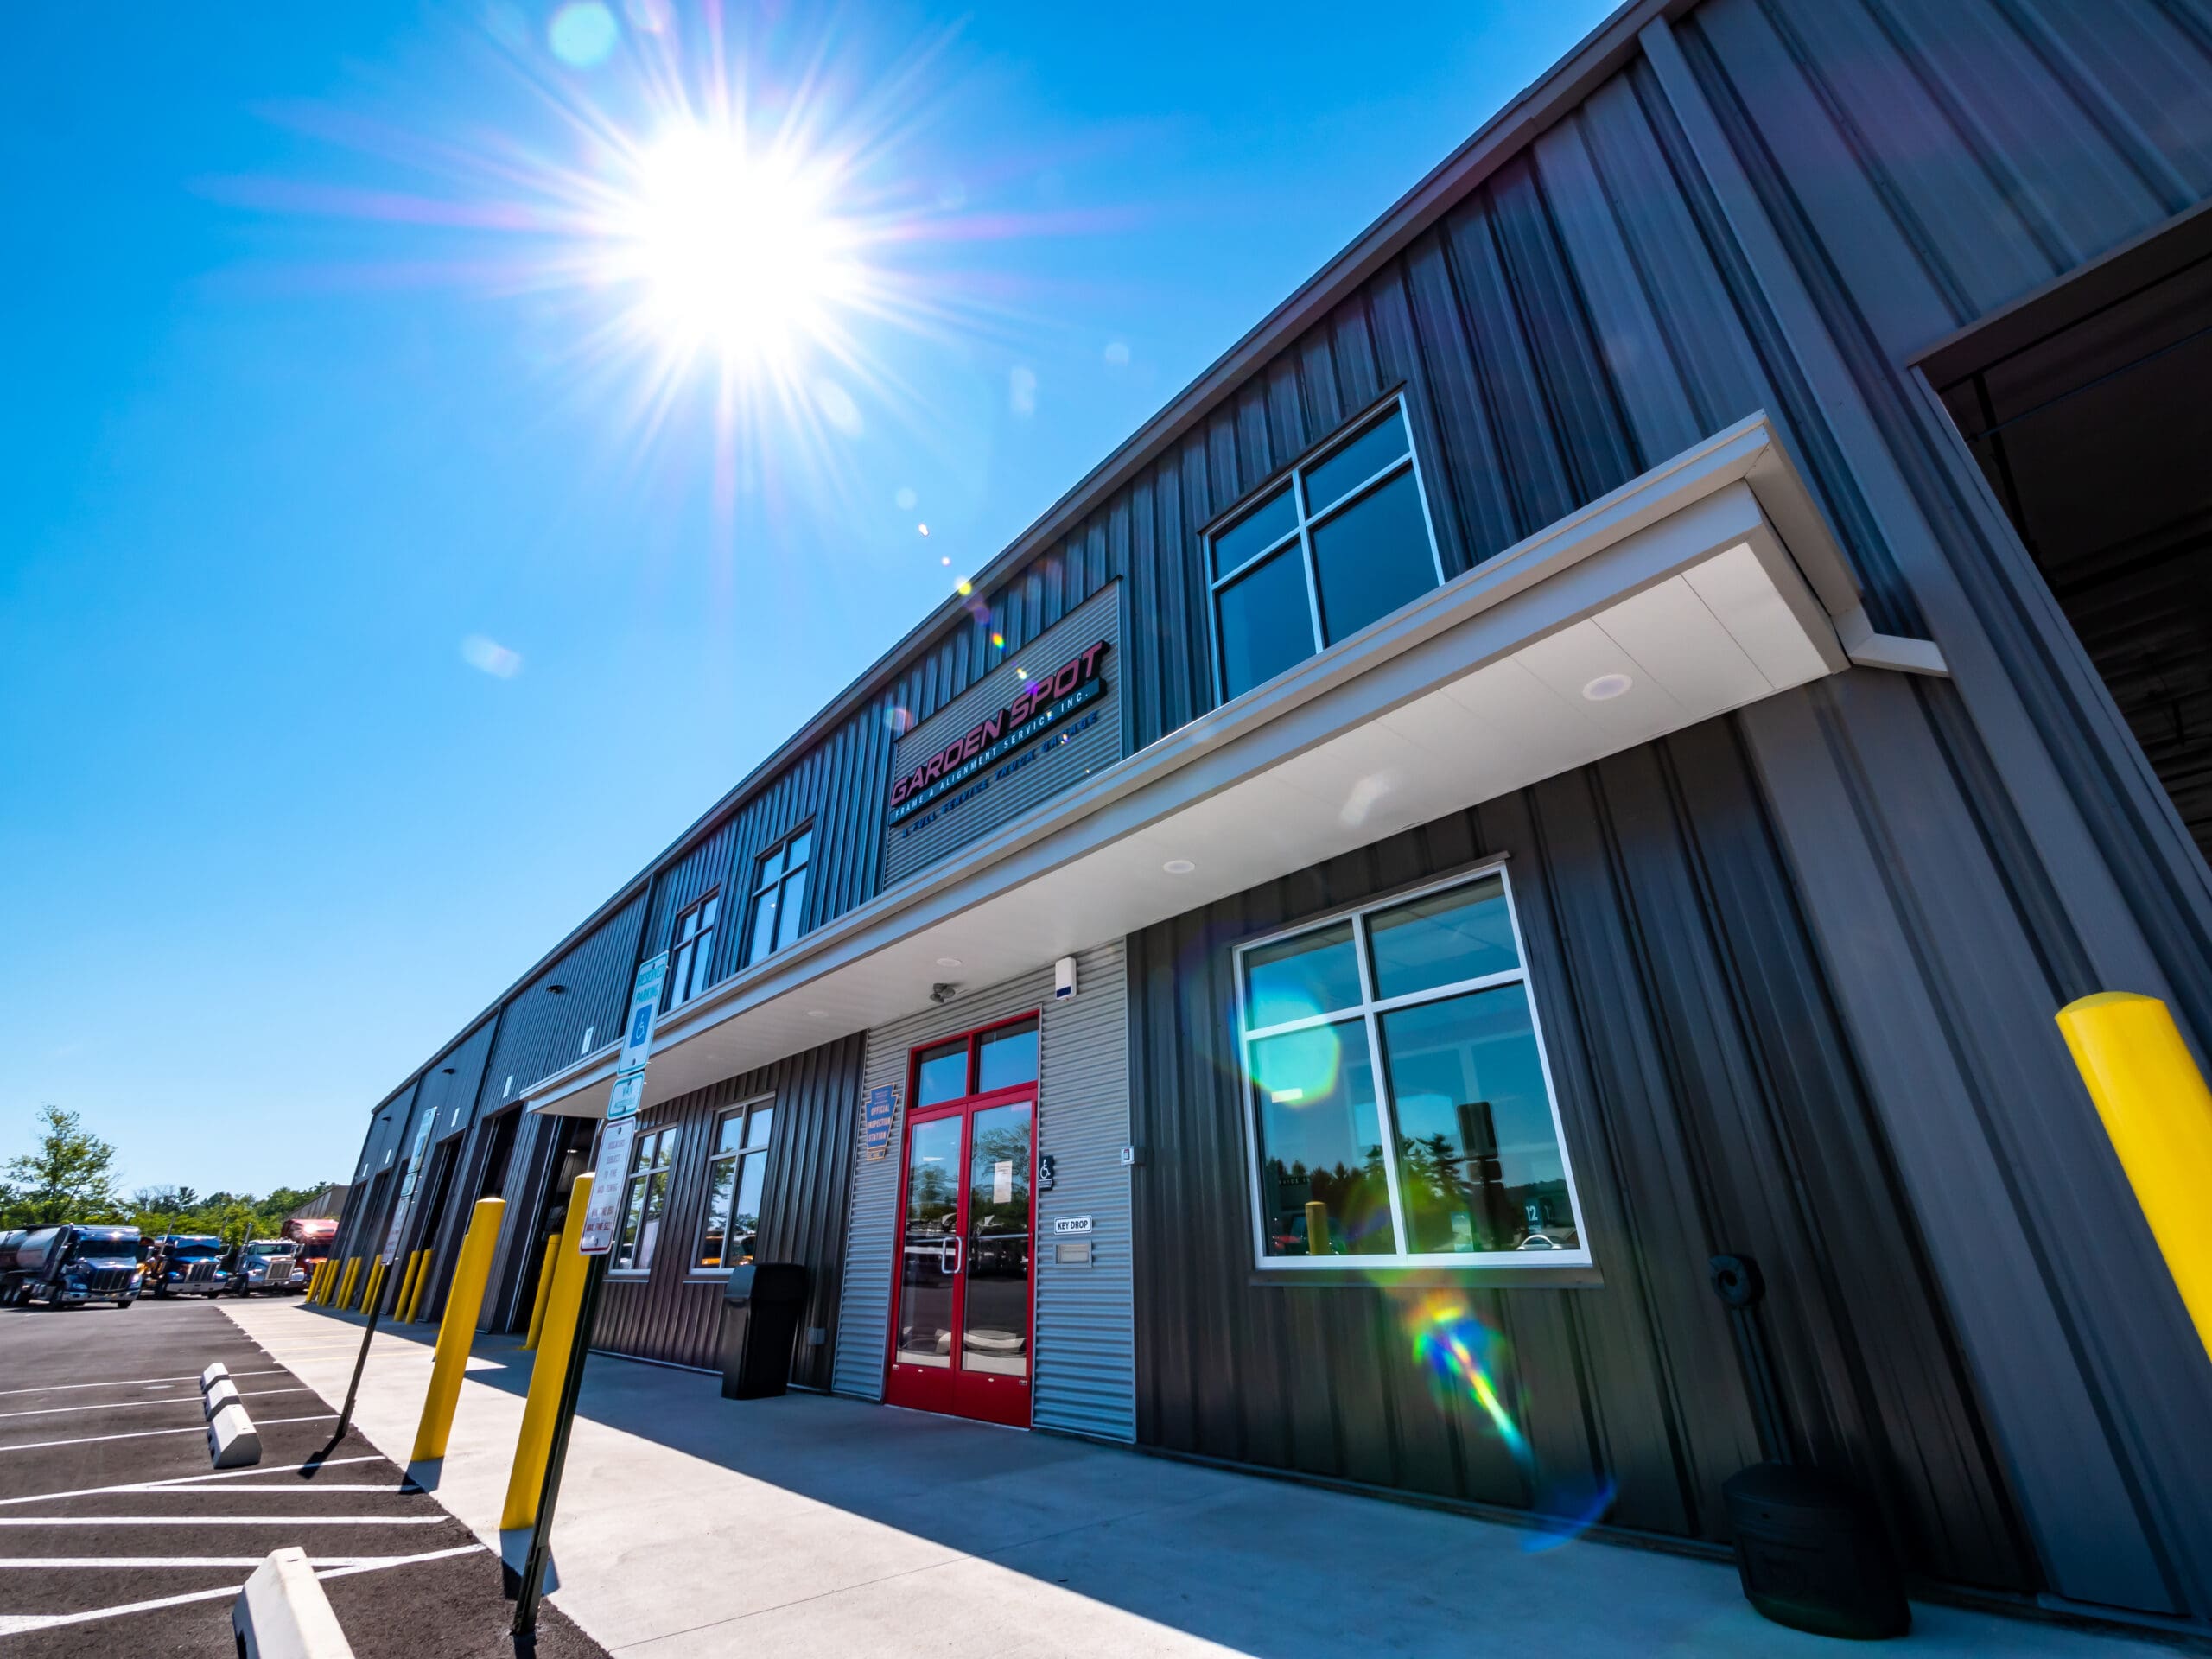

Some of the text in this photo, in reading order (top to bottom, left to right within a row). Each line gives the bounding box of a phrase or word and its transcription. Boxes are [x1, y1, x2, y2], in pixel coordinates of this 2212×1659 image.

[891, 641, 1103, 806] GARDEN SPOT
[895, 797, 924, 818] FRAME
[939, 747, 997, 790] ALIGNMENT
[1004, 710, 1053, 749] SERVICE
[1061, 692, 1089, 712] INC.
[1071, 1220, 1089, 1229] DROP
[1525, 1205, 1538, 1221] 12
